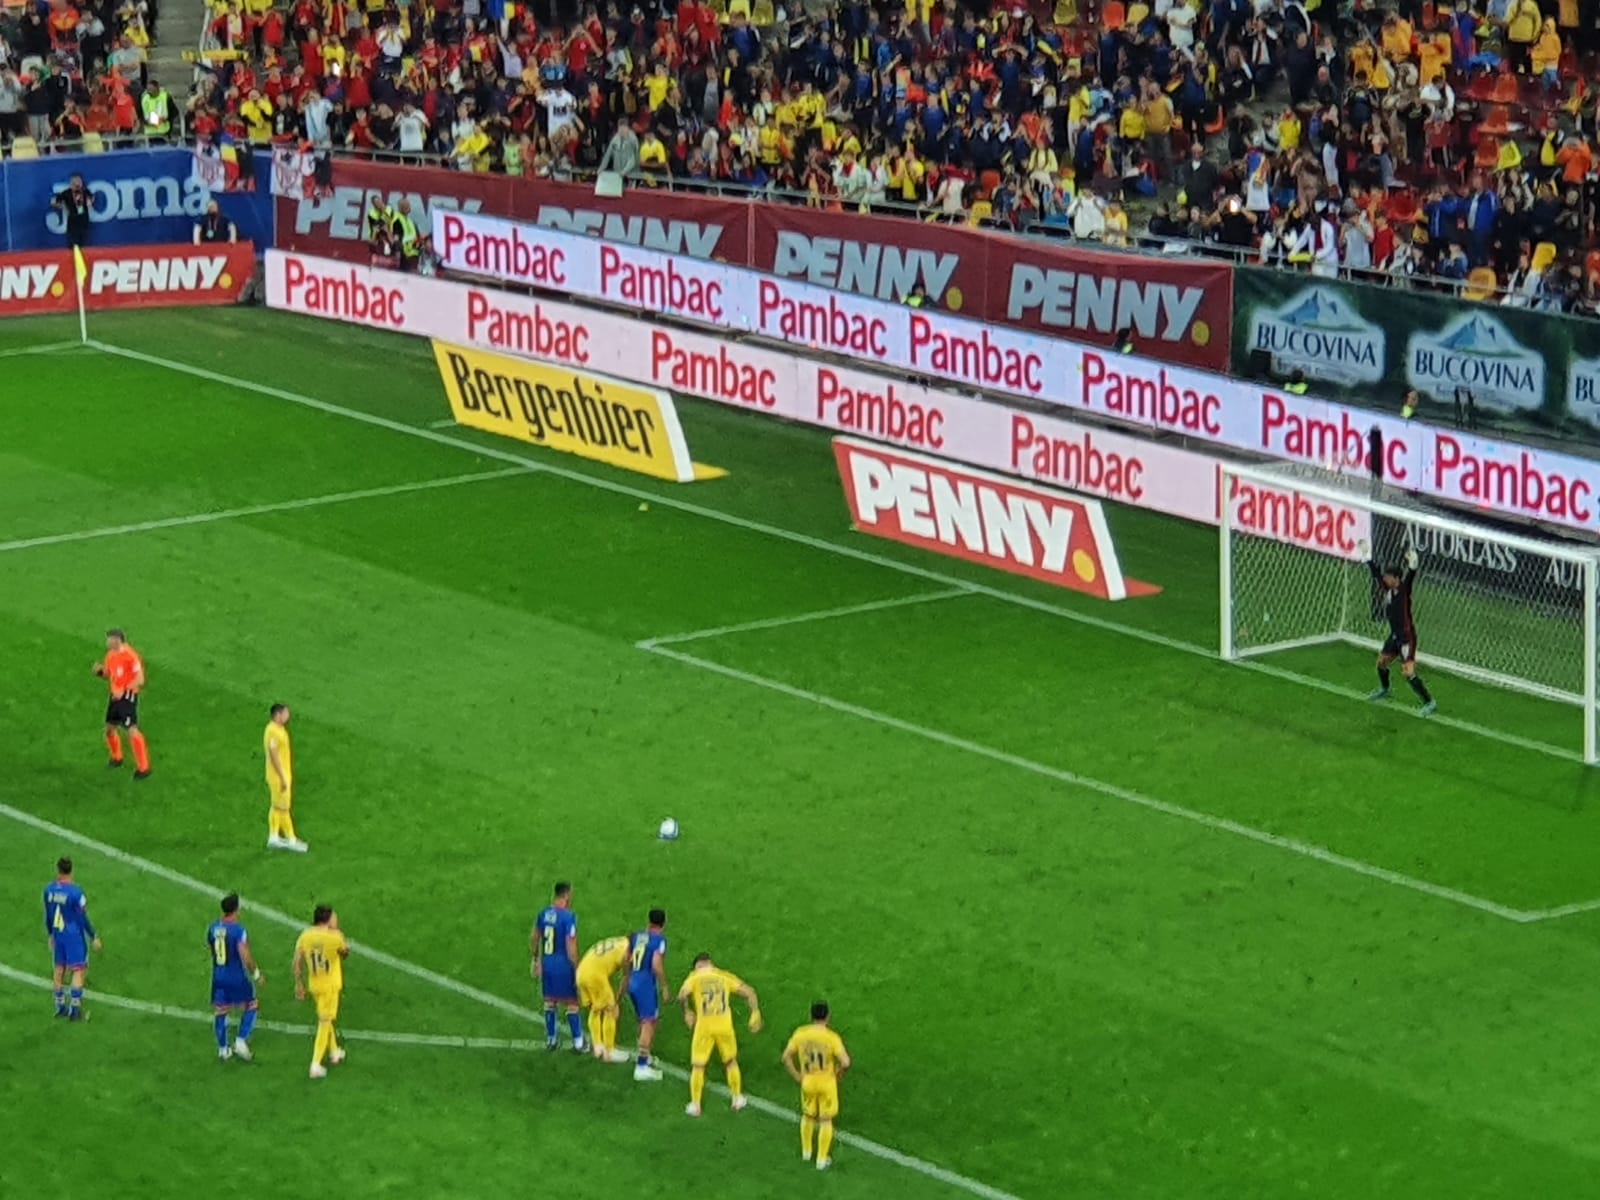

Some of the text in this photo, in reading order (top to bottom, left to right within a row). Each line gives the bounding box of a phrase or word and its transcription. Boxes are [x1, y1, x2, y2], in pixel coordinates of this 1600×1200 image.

[285, 257, 405, 325] Pambac
[467, 290, 590, 363] Pambac
[652, 329, 776, 408] Pambac
[817, 369, 944, 449] Pambac
[1012, 415, 1143, 499] Pambac
[444, 215, 566, 285] Pambac
[600, 246, 723, 317] Pambac
[758, 279, 888, 357] Pambac
[910, 311, 1042, 393] Pambac
[1082, 353, 1221, 435] Pambac
[1435, 435, 1591, 522] Pambac
[1256, 322, 1377, 367] BUCOVINA
[1415, 349, 1535, 393] BUCOVINA
[447, 352, 655, 459] Bergenbier
[1401, 521, 1518, 573] AUTOKLASS
